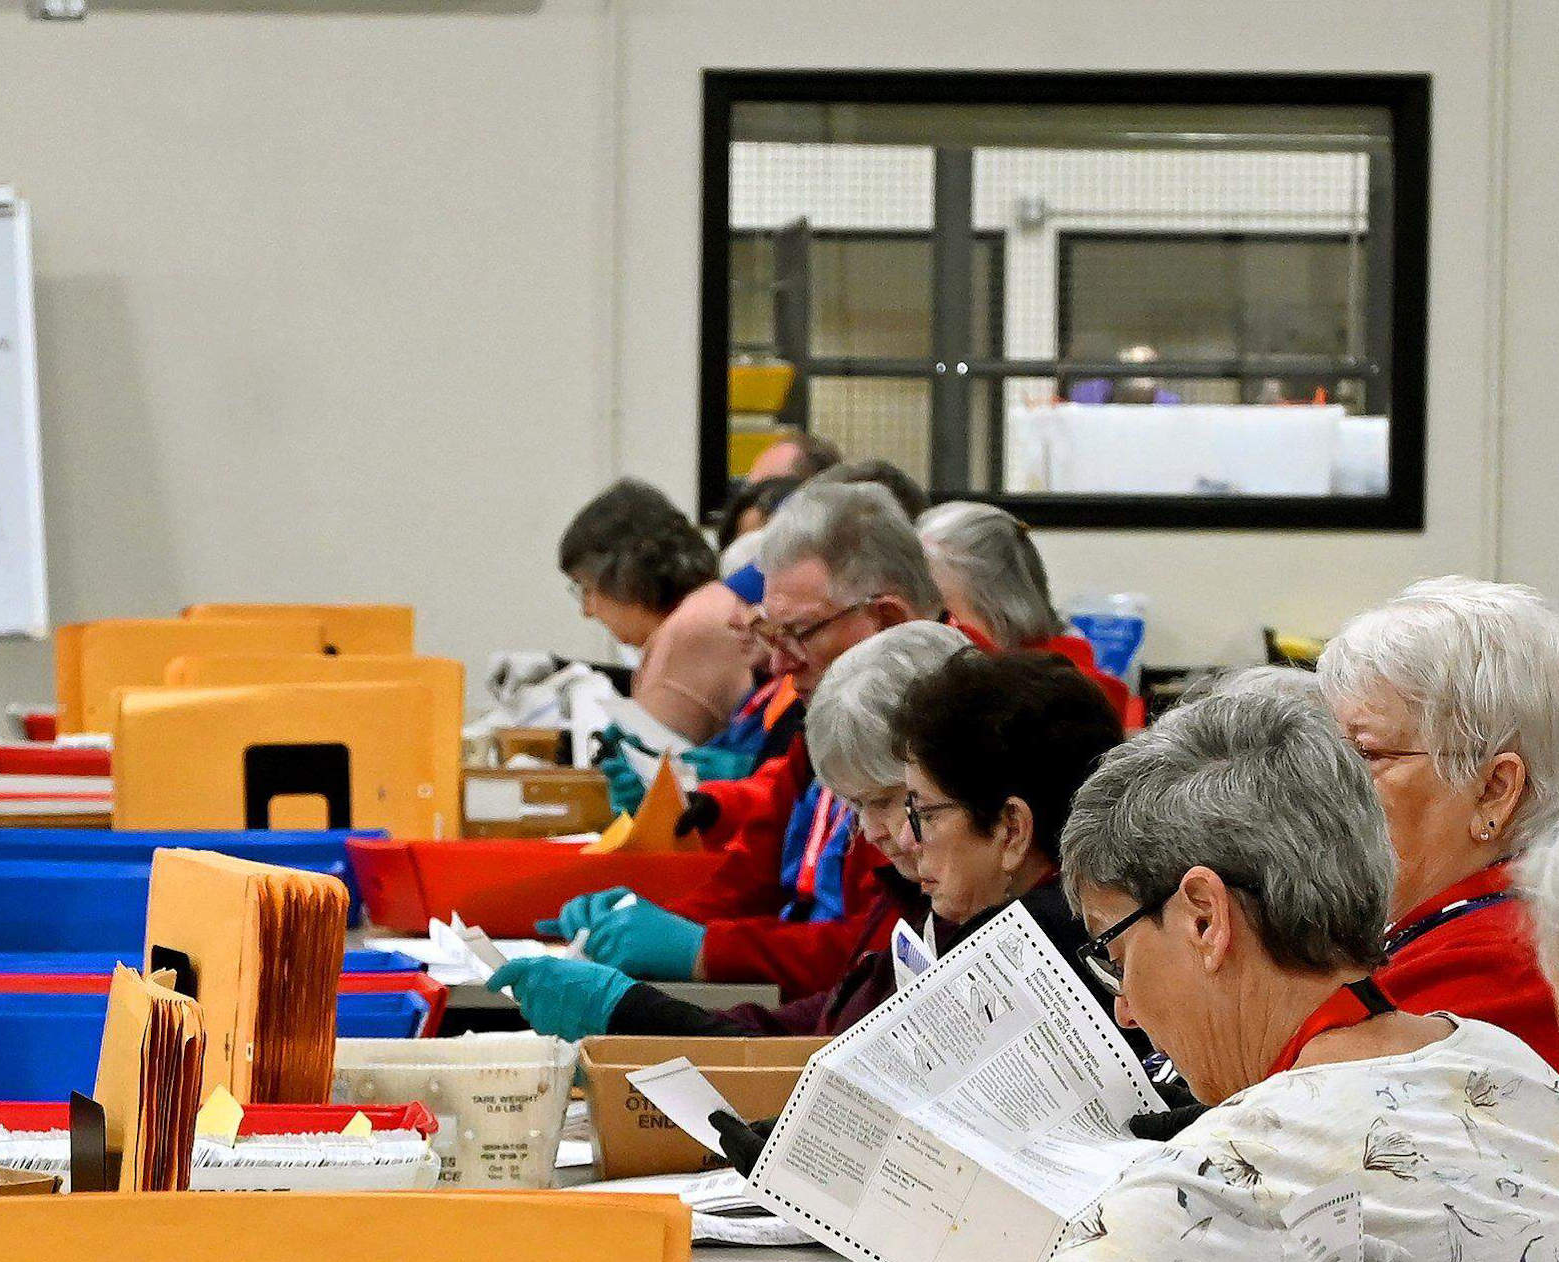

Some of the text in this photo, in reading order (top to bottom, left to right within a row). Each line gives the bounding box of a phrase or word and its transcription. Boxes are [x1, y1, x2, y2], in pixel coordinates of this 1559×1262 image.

[1024, 978, 1051, 1011] November
[1064, 1036, 1086, 1061] General
[1083, 1062, 1106, 1089] Election
[1030, 973, 1101, 1068] Thurston County, Washington
[1036, 968, 1071, 1011] Official Ballot
